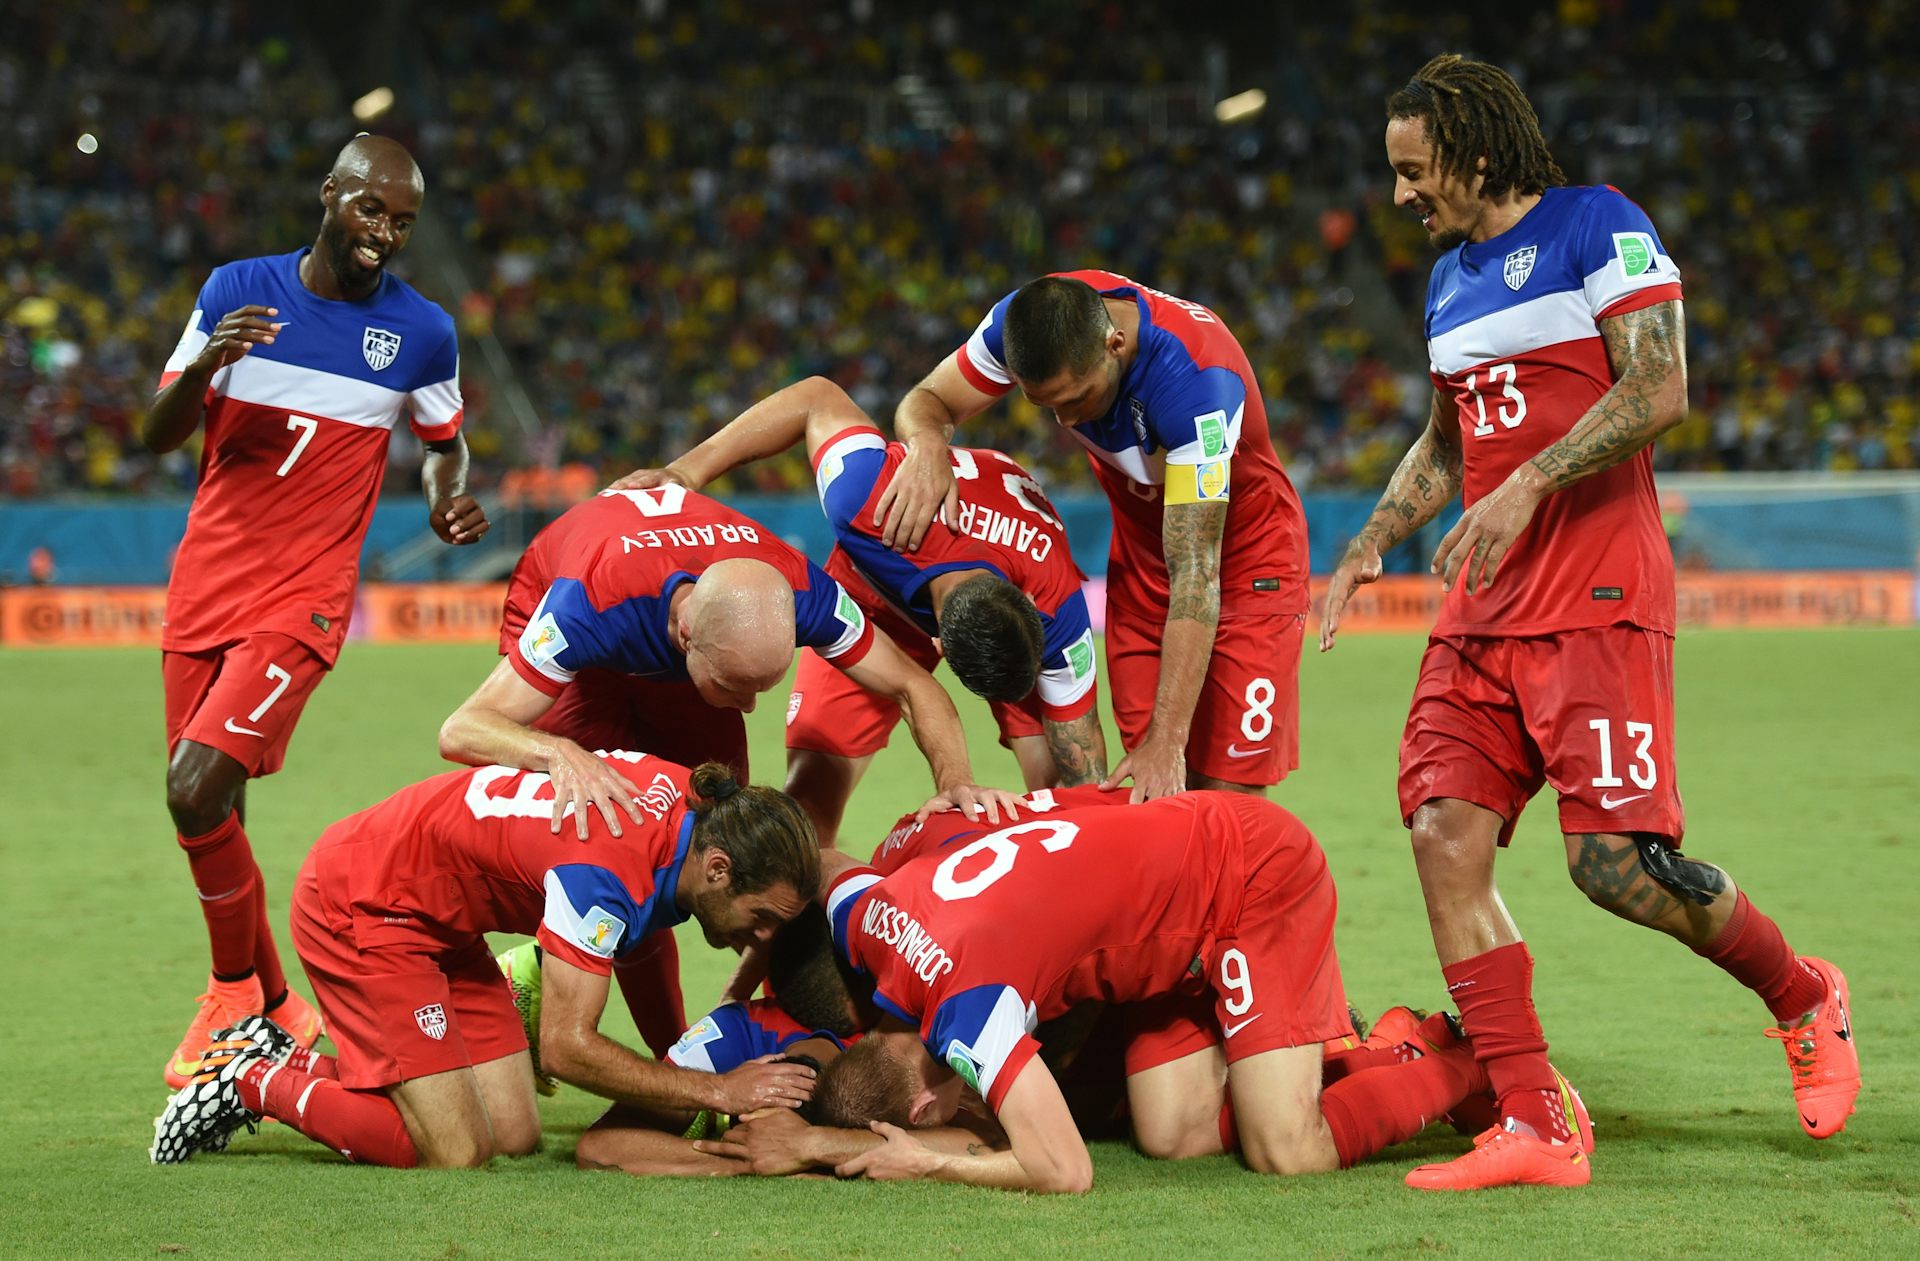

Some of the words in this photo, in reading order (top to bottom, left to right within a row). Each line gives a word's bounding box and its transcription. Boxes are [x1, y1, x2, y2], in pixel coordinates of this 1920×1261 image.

[1465, 363, 1527, 437] 13
[275, 413, 319, 477] 7
[620, 523, 760, 555] BRADLEY
[933, 499, 1053, 563] CAMER
[247, 662, 293, 723] 7
[1240, 677, 1276, 742] 8
[1588, 718, 1658, 791] 13
[1220, 947, 1255, 1017] 9
